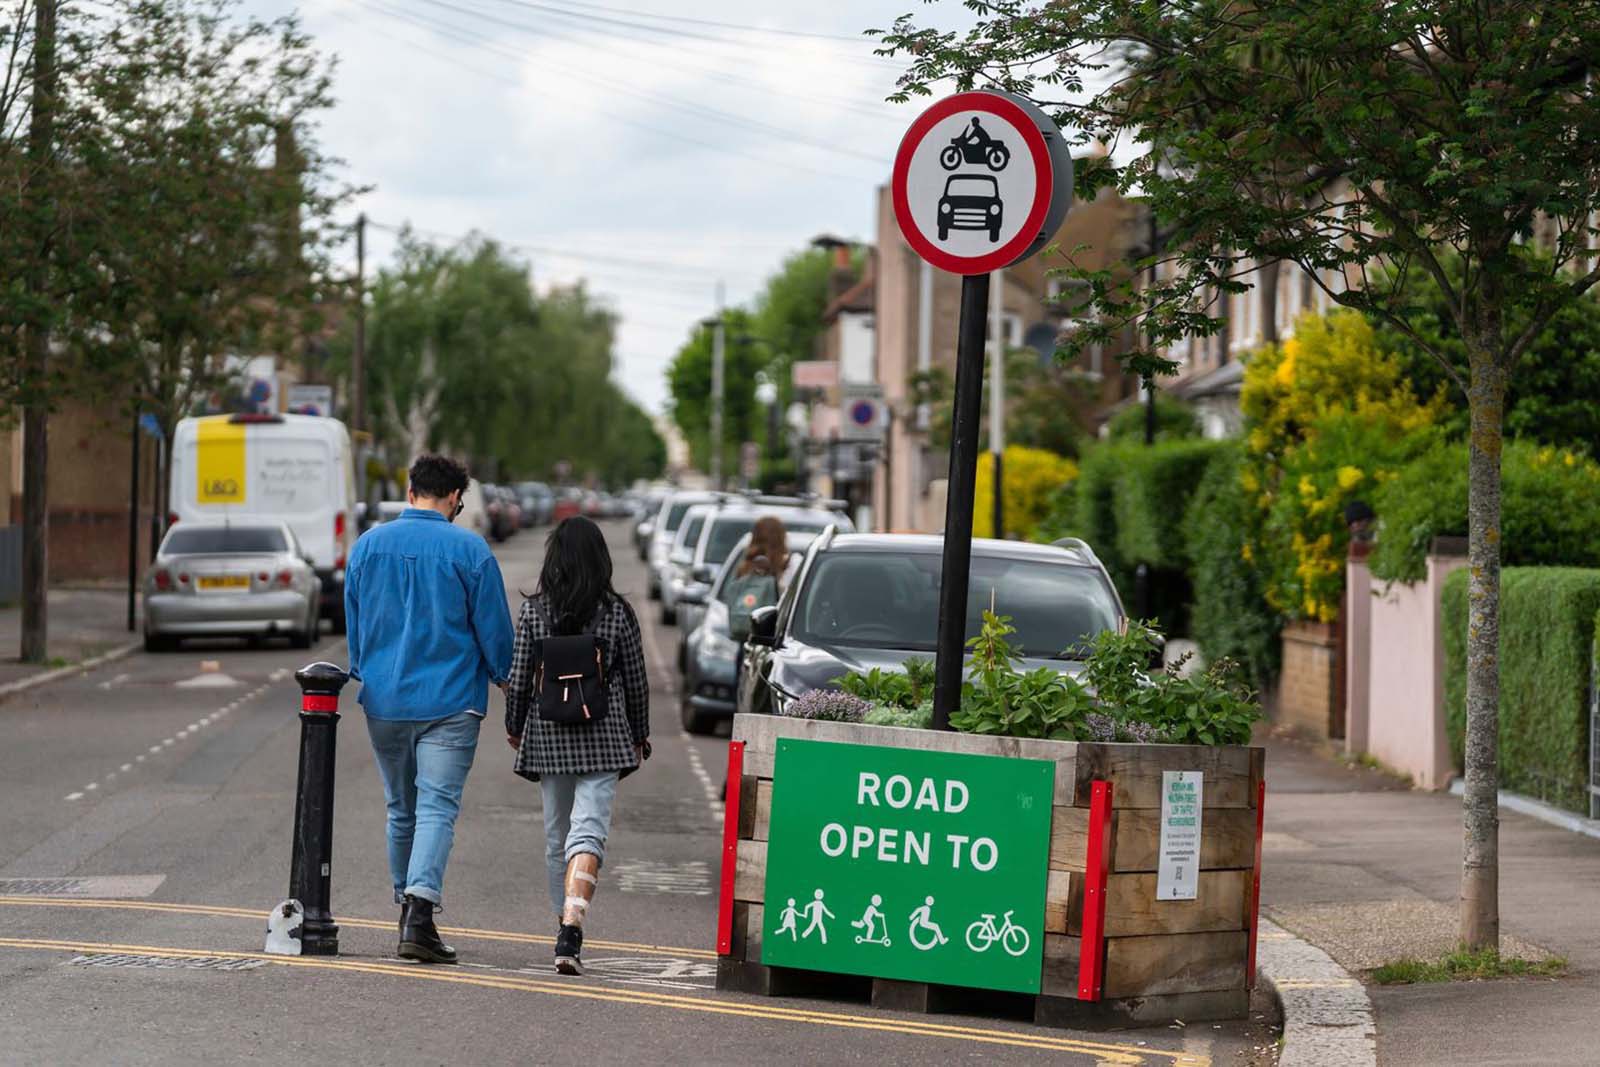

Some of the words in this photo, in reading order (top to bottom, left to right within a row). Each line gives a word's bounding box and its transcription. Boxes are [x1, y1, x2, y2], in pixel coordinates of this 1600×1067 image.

[857, 772, 969, 813] ROAD
[820, 822, 931, 865] OPEN
[946, 834, 999, 872] TO
